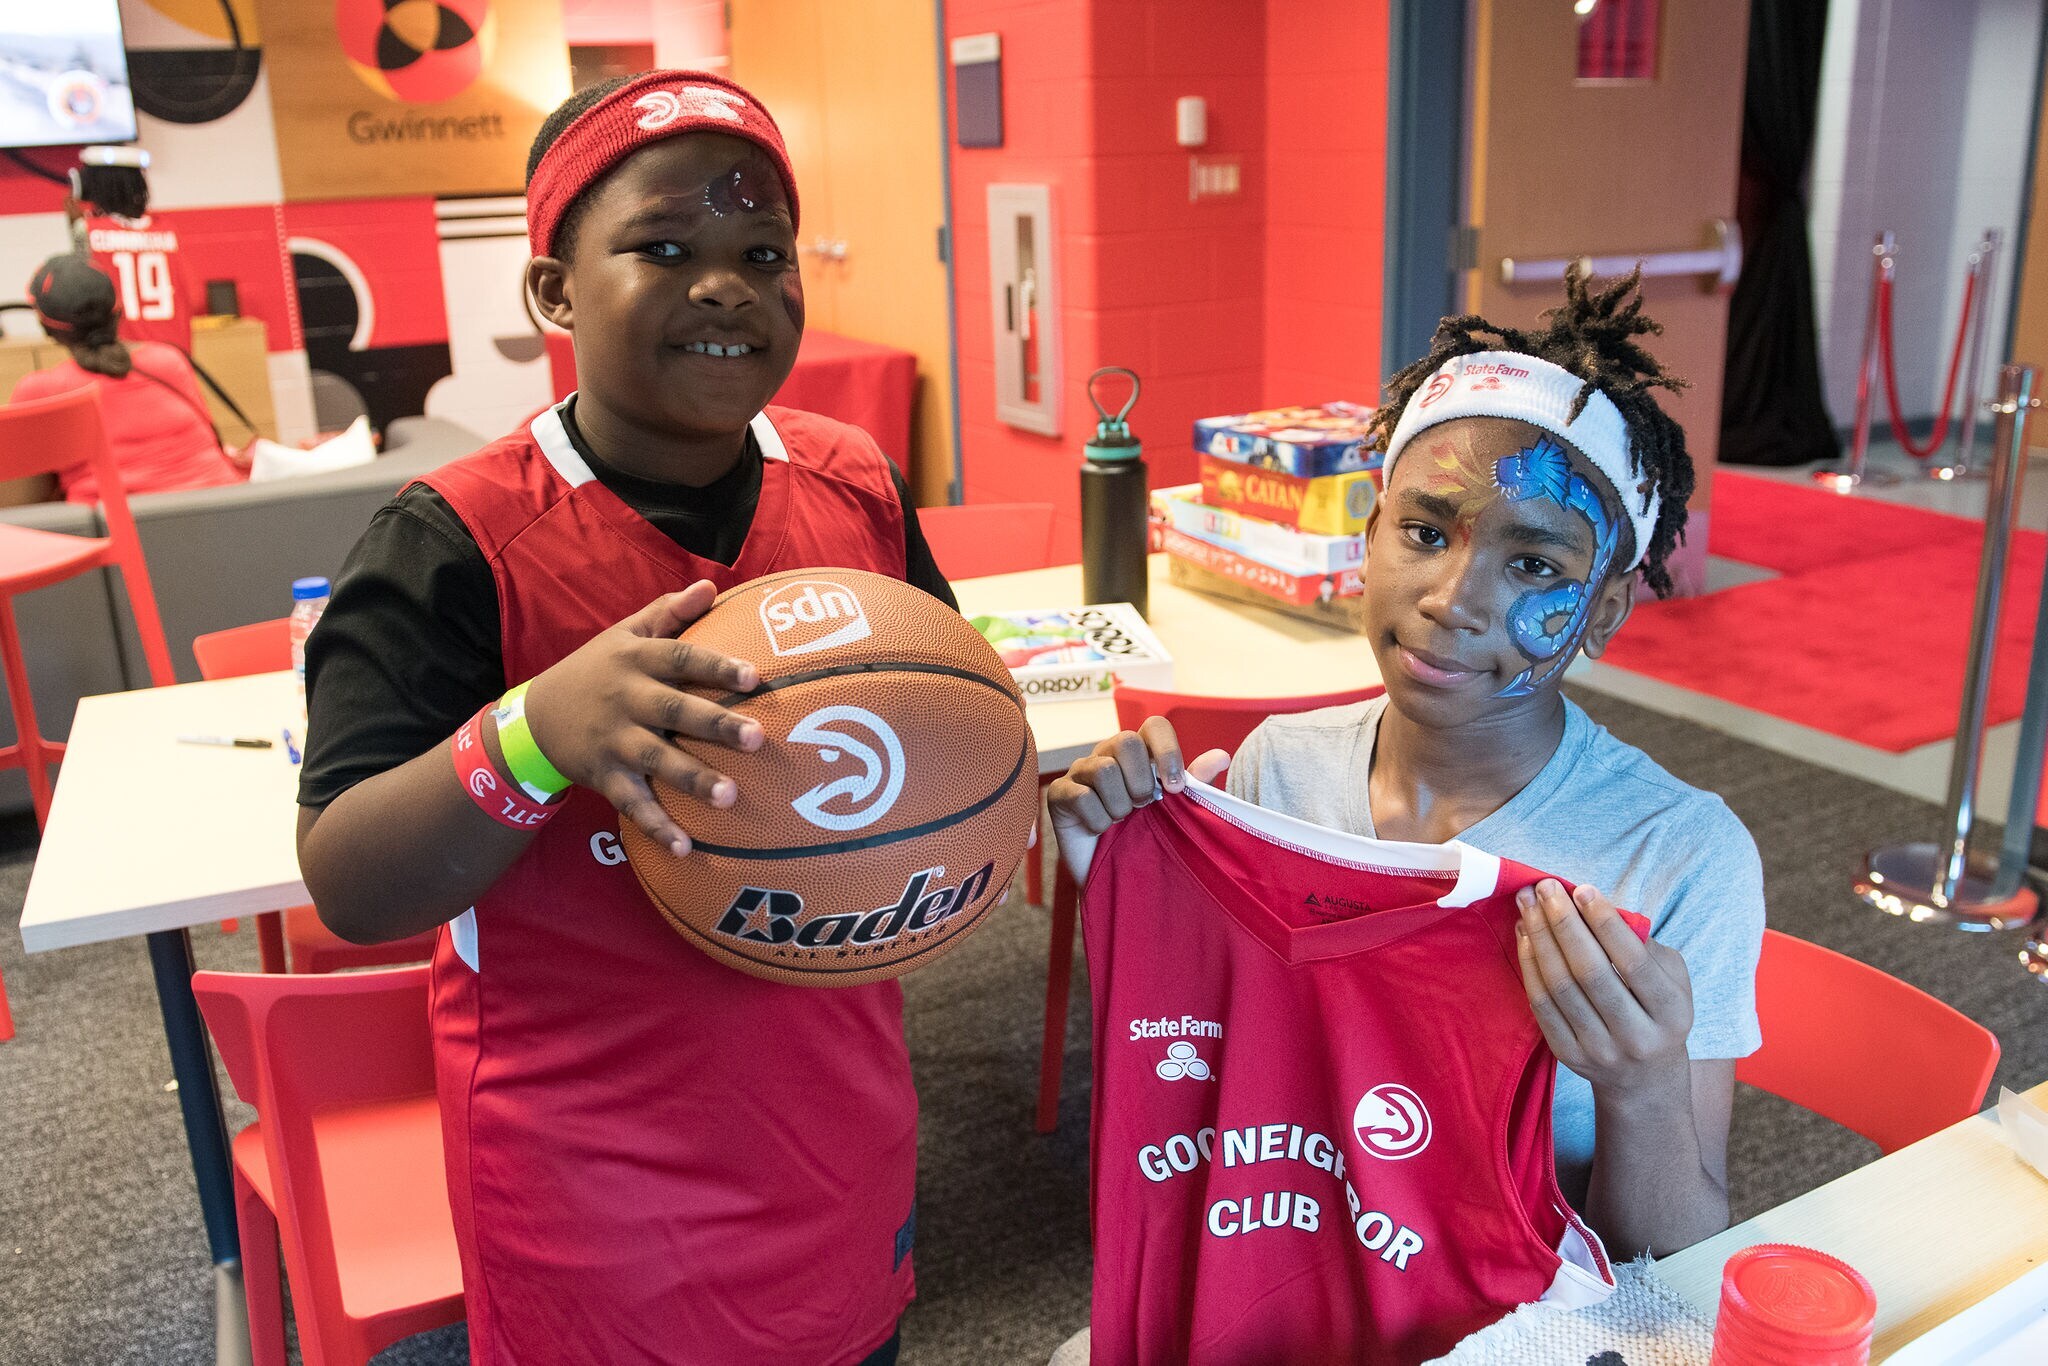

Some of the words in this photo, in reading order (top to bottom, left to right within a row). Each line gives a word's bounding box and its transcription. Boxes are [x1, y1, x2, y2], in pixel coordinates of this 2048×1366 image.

[347, 110, 505, 145] Gwinnett
[112, 251, 175, 321] 19
[1245, 474, 1304, 511] CATAN
[768, 586, 857, 632] sdn
[713, 866, 995, 949] Baden
[1324, 895, 1373, 912] AUGUSTA
[1207, 1191, 1321, 1238] CLUB
